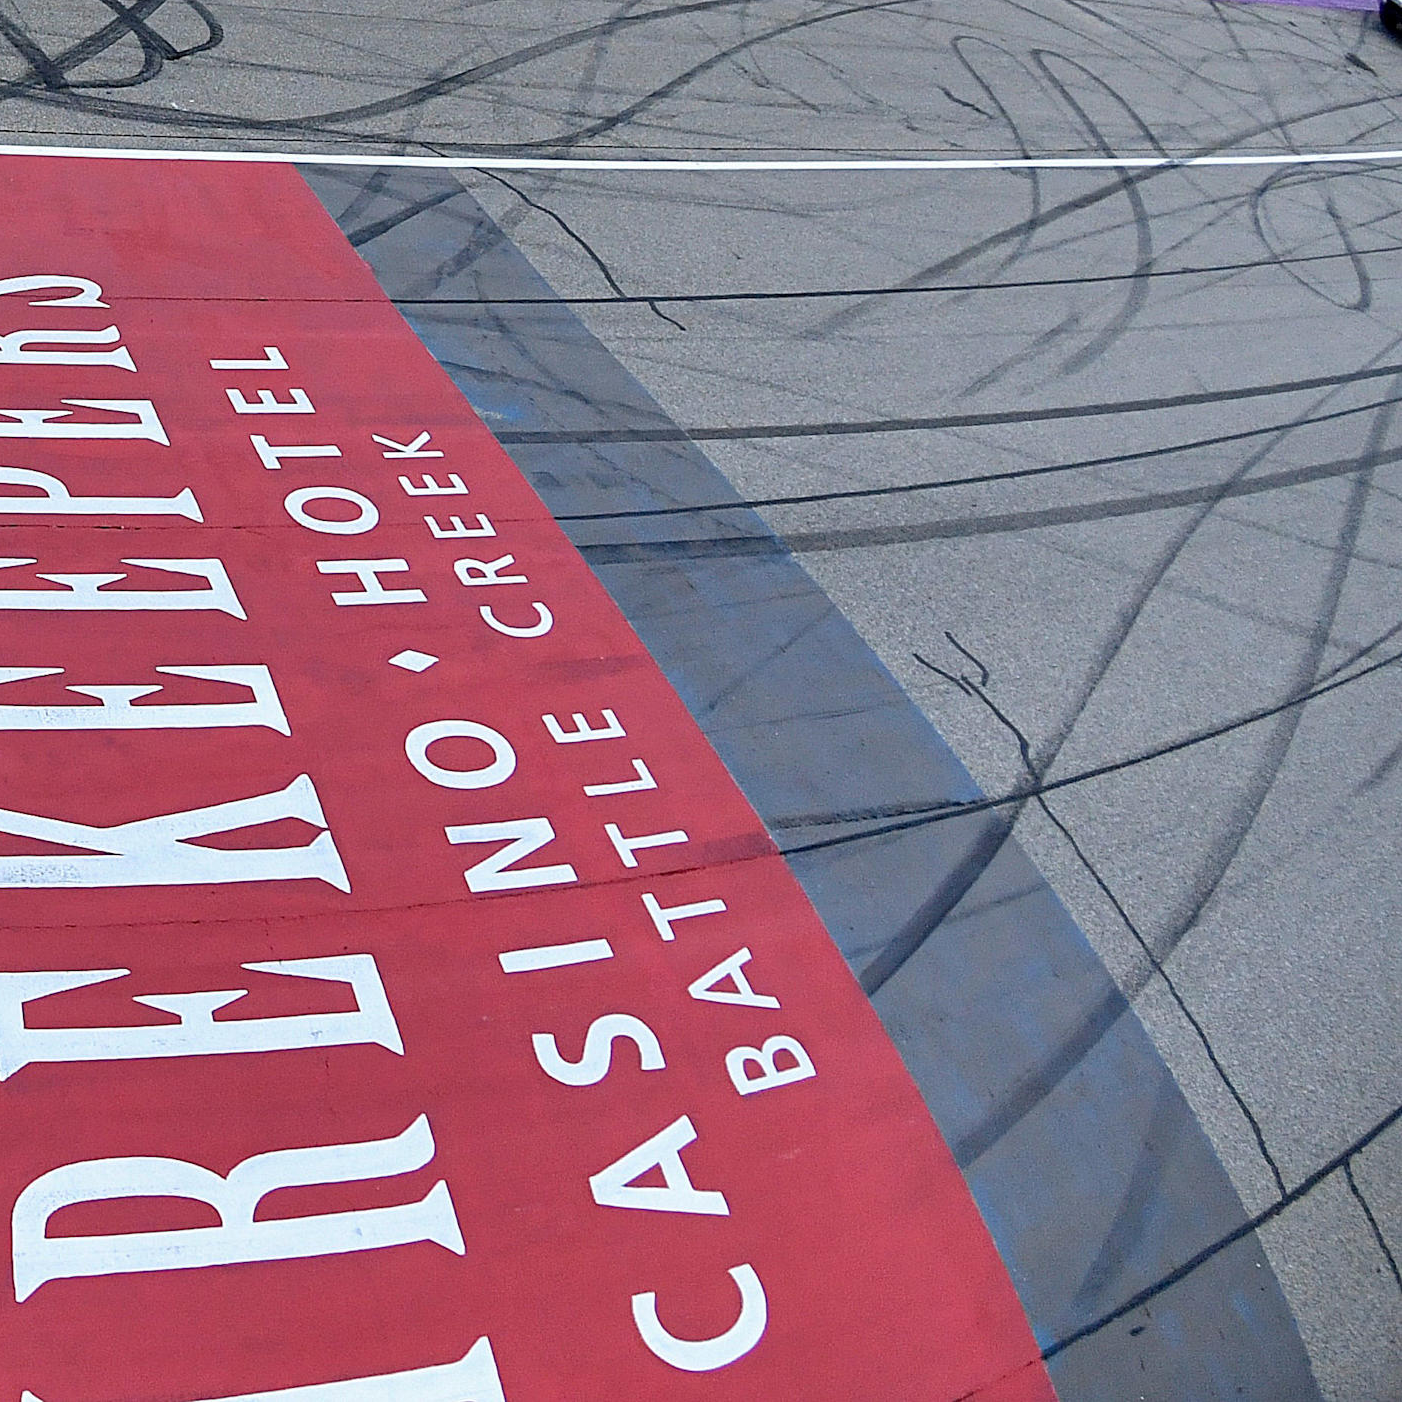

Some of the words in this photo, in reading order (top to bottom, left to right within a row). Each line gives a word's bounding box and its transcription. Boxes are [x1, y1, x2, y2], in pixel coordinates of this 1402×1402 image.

[209, 345, 429, 606] HOTEL
[371, 429, 554, 639] CREEK
[403, 718, 769, 1373] CASINO
[542, 706, 817, 1096] BATTLE
